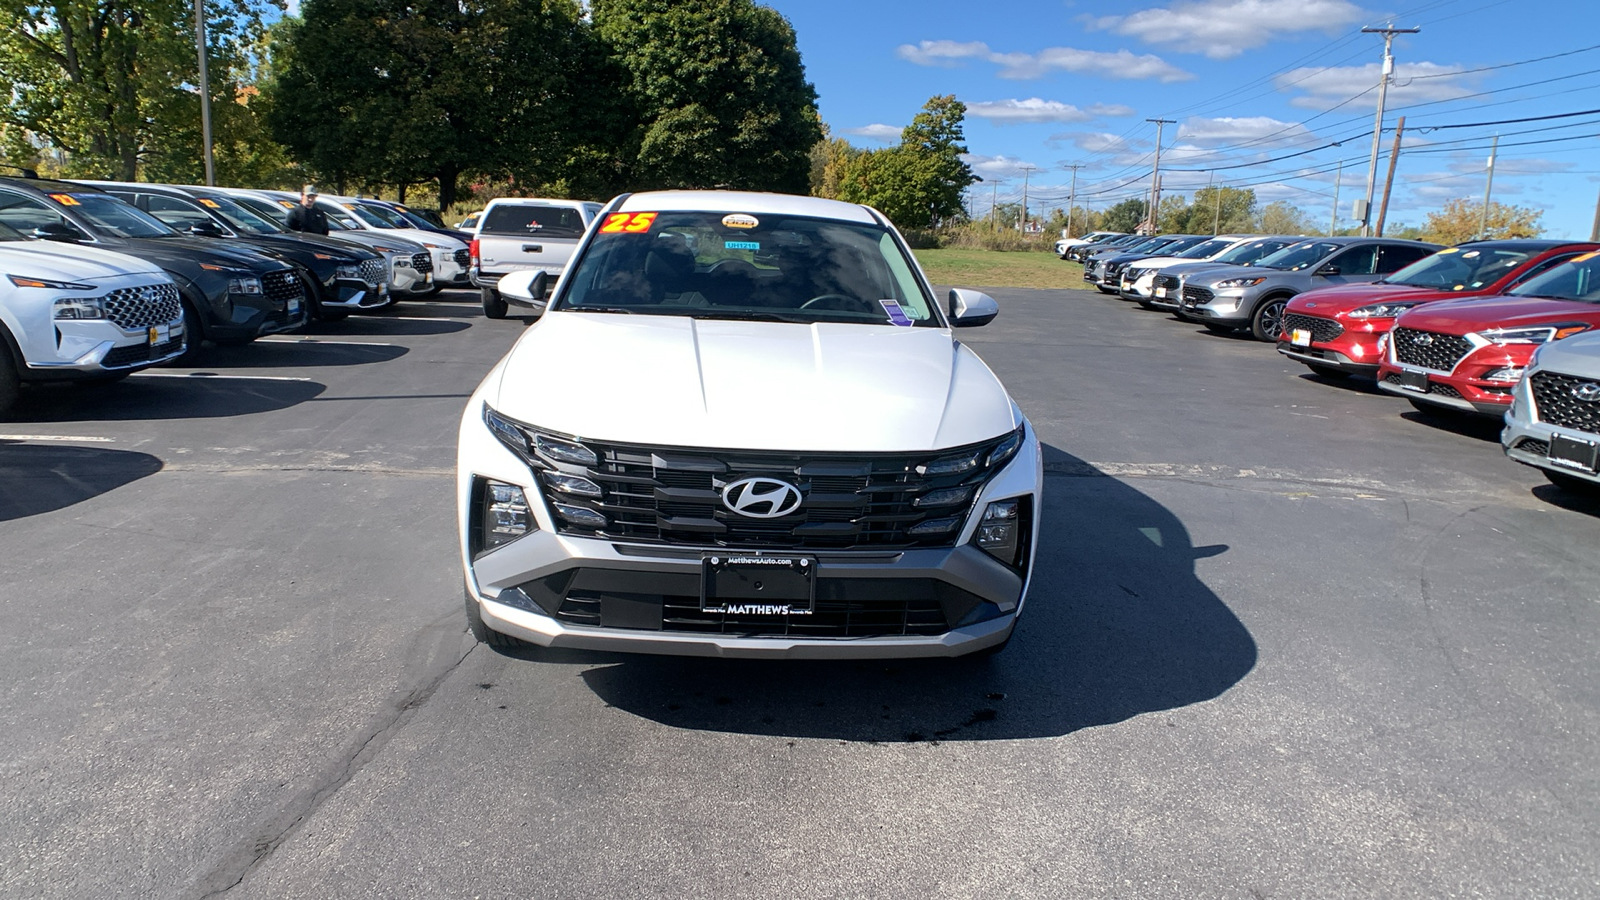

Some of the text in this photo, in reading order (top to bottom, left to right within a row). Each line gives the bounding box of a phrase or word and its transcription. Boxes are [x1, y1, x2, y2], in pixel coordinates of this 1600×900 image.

[602, 212, 657, 232] 25
[728, 557, 792, 565] MatthewsAuto.com
[727, 604, 789, 615] MATTHEWS
